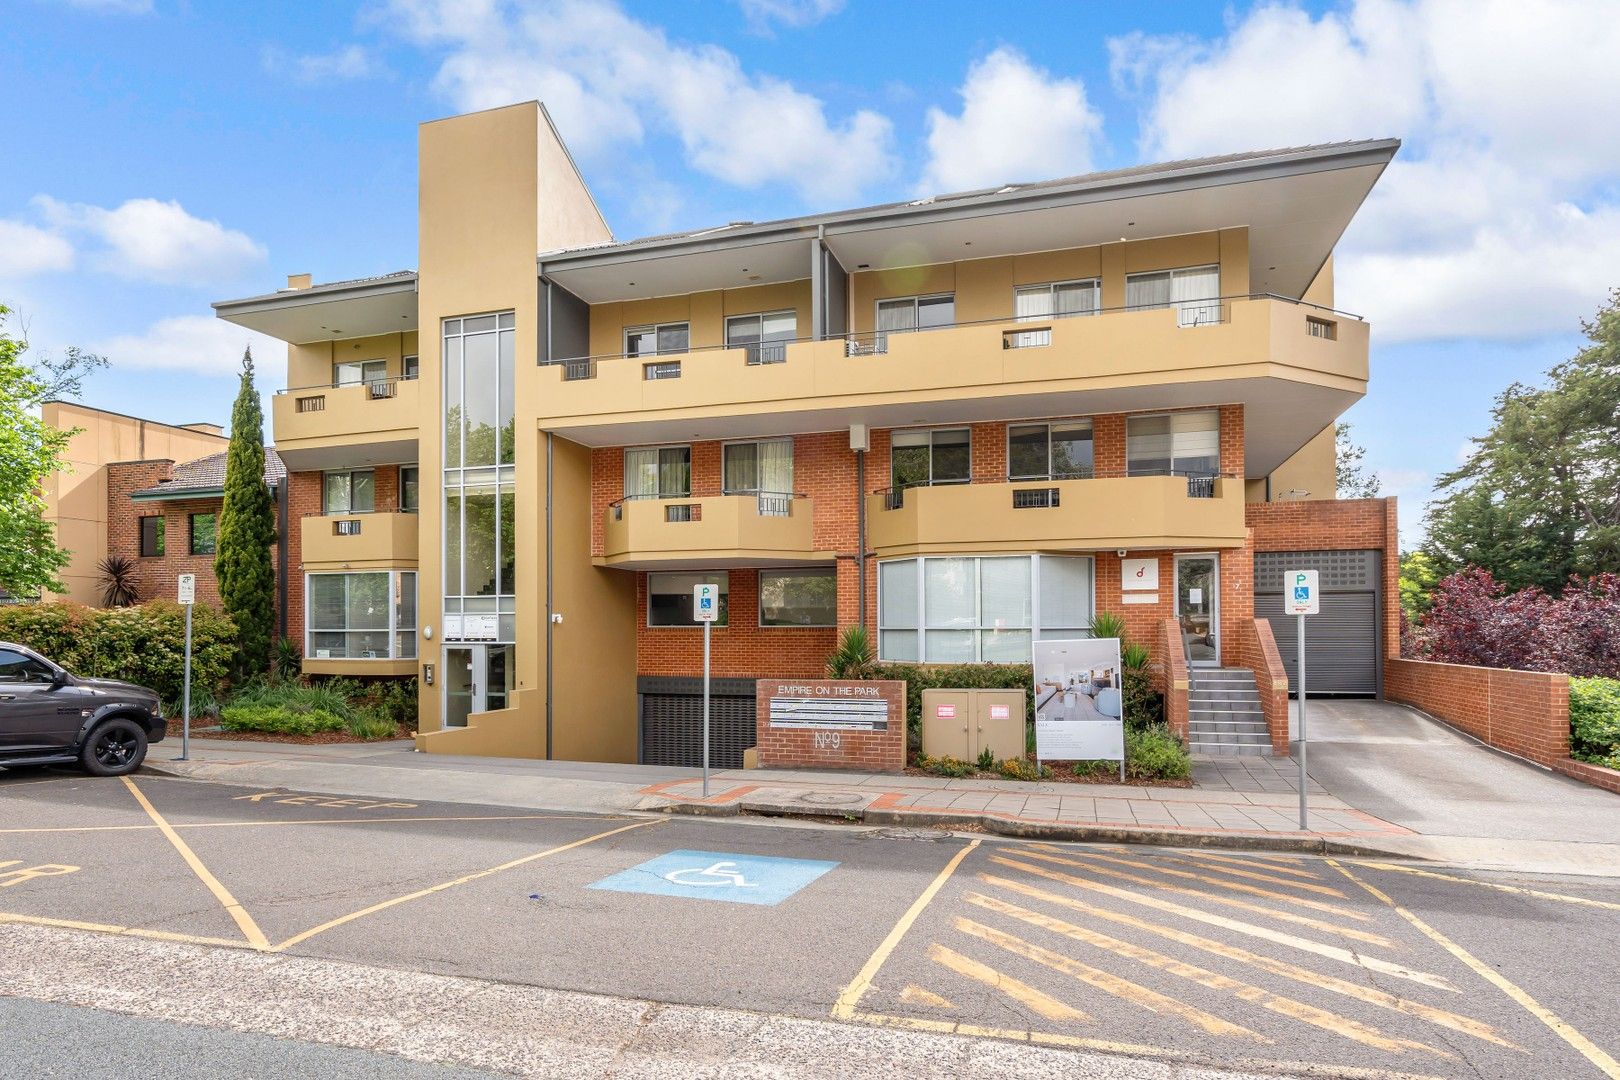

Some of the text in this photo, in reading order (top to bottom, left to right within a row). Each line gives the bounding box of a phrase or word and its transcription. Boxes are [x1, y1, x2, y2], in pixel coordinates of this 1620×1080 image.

[1296, 573, 1306, 585] P
[702, 587, 709, 596] P
[778, 685, 880, 696] EMPIRE ON THE PARK
[232, 792, 418, 809] KEEP
